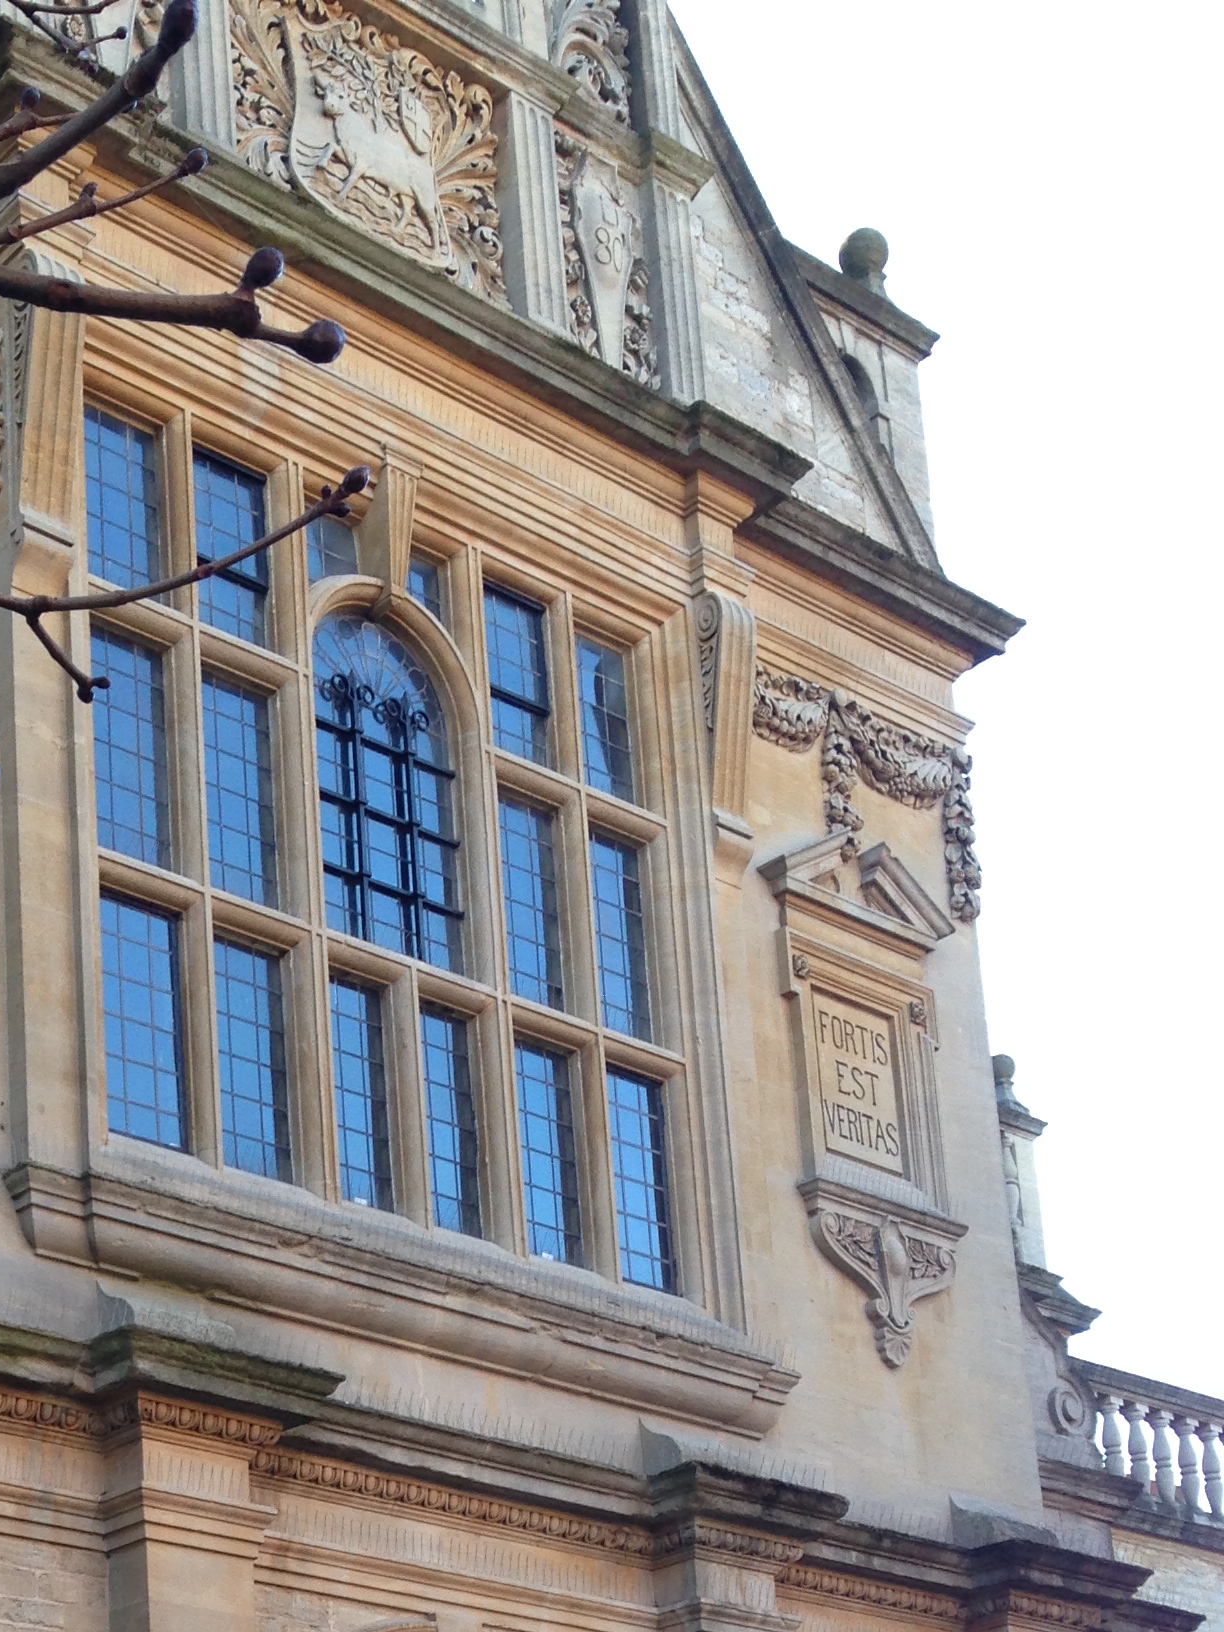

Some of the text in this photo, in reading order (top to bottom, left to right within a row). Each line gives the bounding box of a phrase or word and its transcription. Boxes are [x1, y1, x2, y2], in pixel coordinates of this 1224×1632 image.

[818, 1009, 889, 1067] FORTIS
[834, 1059, 880, 1107] EST
[823, 1100, 900, 1157] VERITAS
